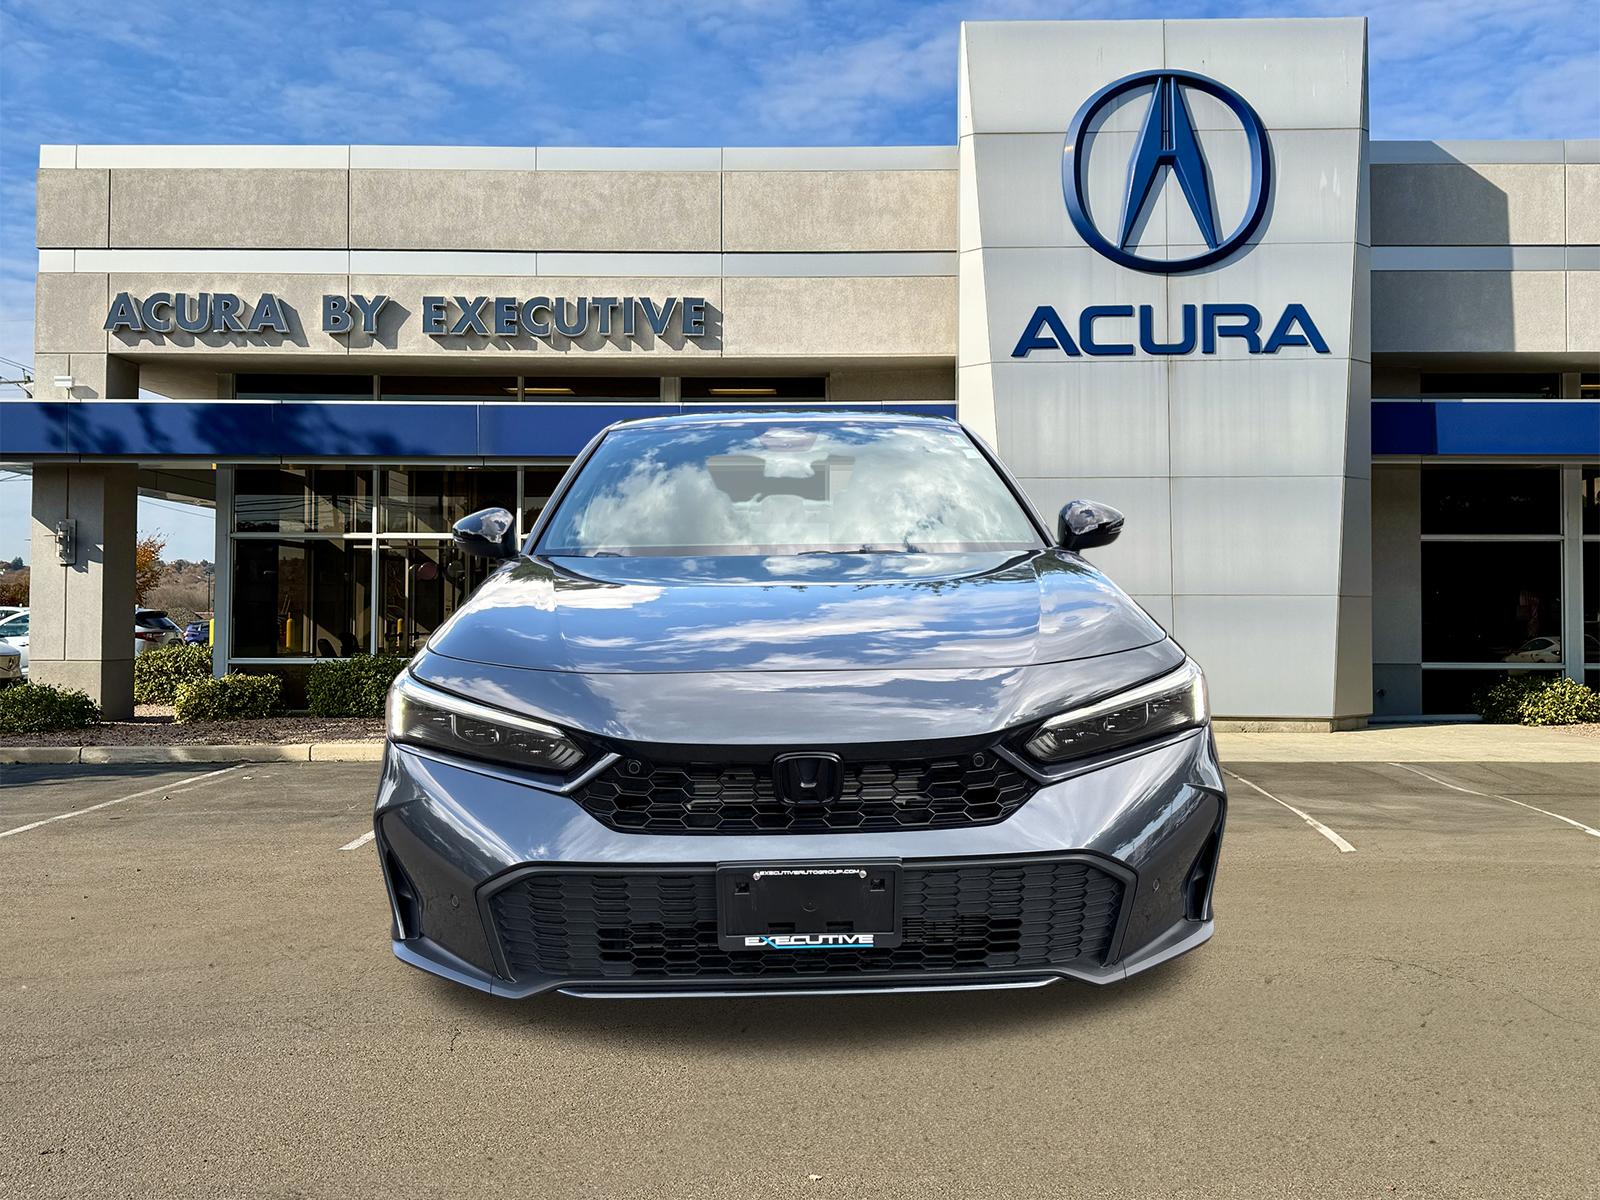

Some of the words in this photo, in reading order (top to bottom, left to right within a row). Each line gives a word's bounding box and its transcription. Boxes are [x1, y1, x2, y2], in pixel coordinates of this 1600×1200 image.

[103, 291, 290, 334] ACURA
[322, 294, 392, 335] BY
[421, 296, 706, 337] EXECUTIVE
[1011, 303, 1332, 358] ACURA
[744, 934, 874, 948] EXECUTIVE
